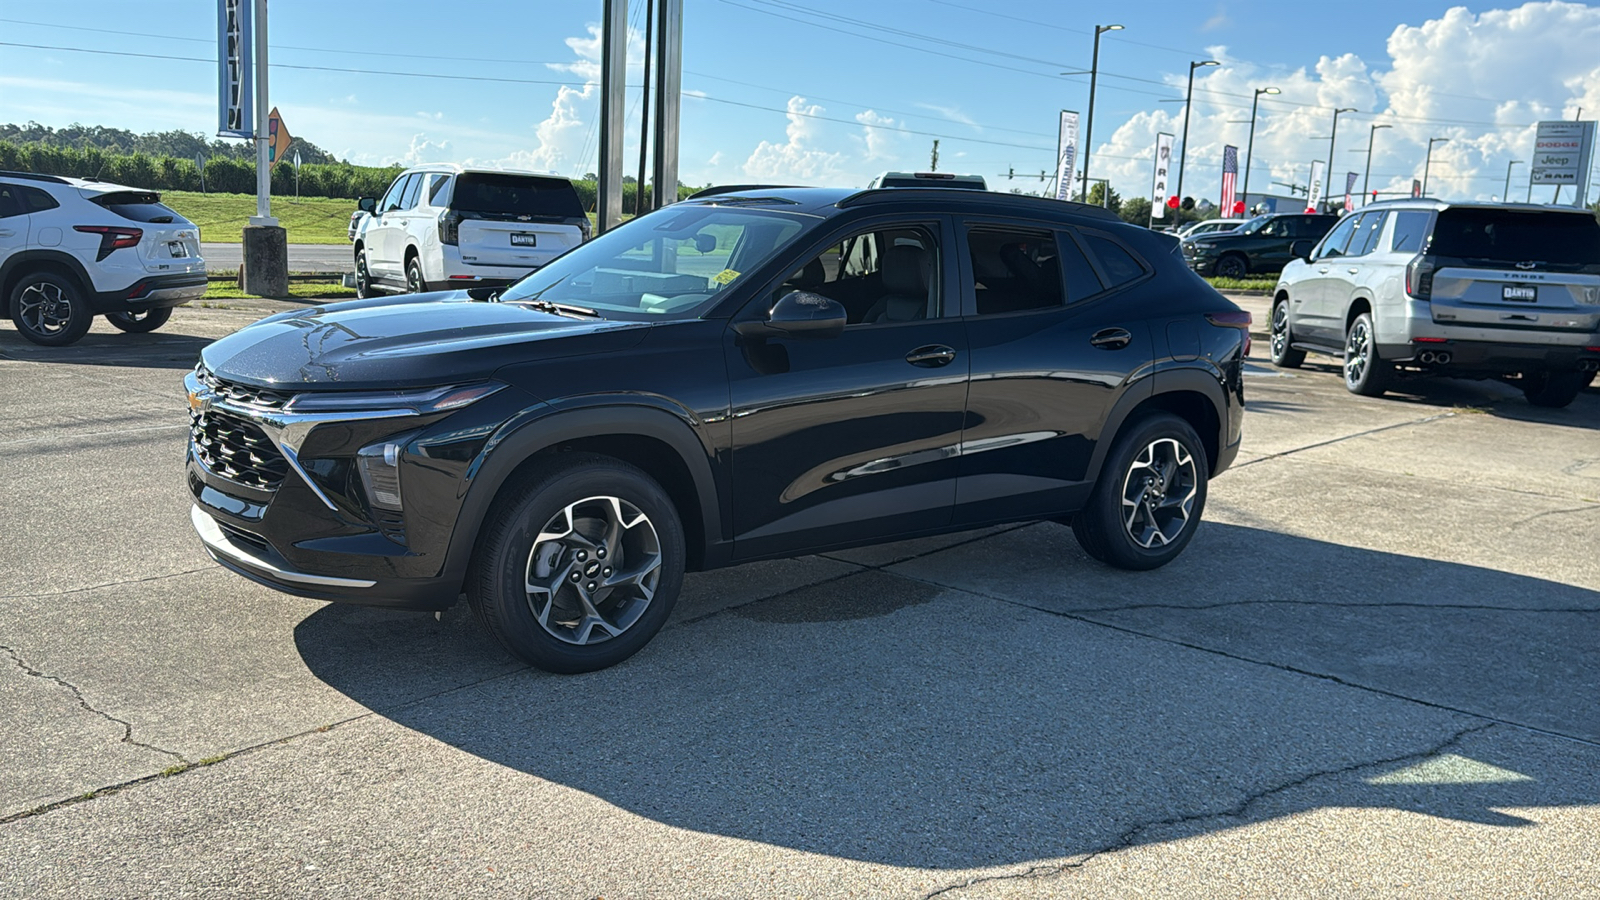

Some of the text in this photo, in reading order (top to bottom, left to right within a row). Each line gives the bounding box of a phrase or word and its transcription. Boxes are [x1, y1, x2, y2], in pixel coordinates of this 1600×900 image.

[1541, 155, 1569, 166] Jeep
[1154, 168, 1167, 203] RAM
[1503, 287, 1535, 298] DANTIN
